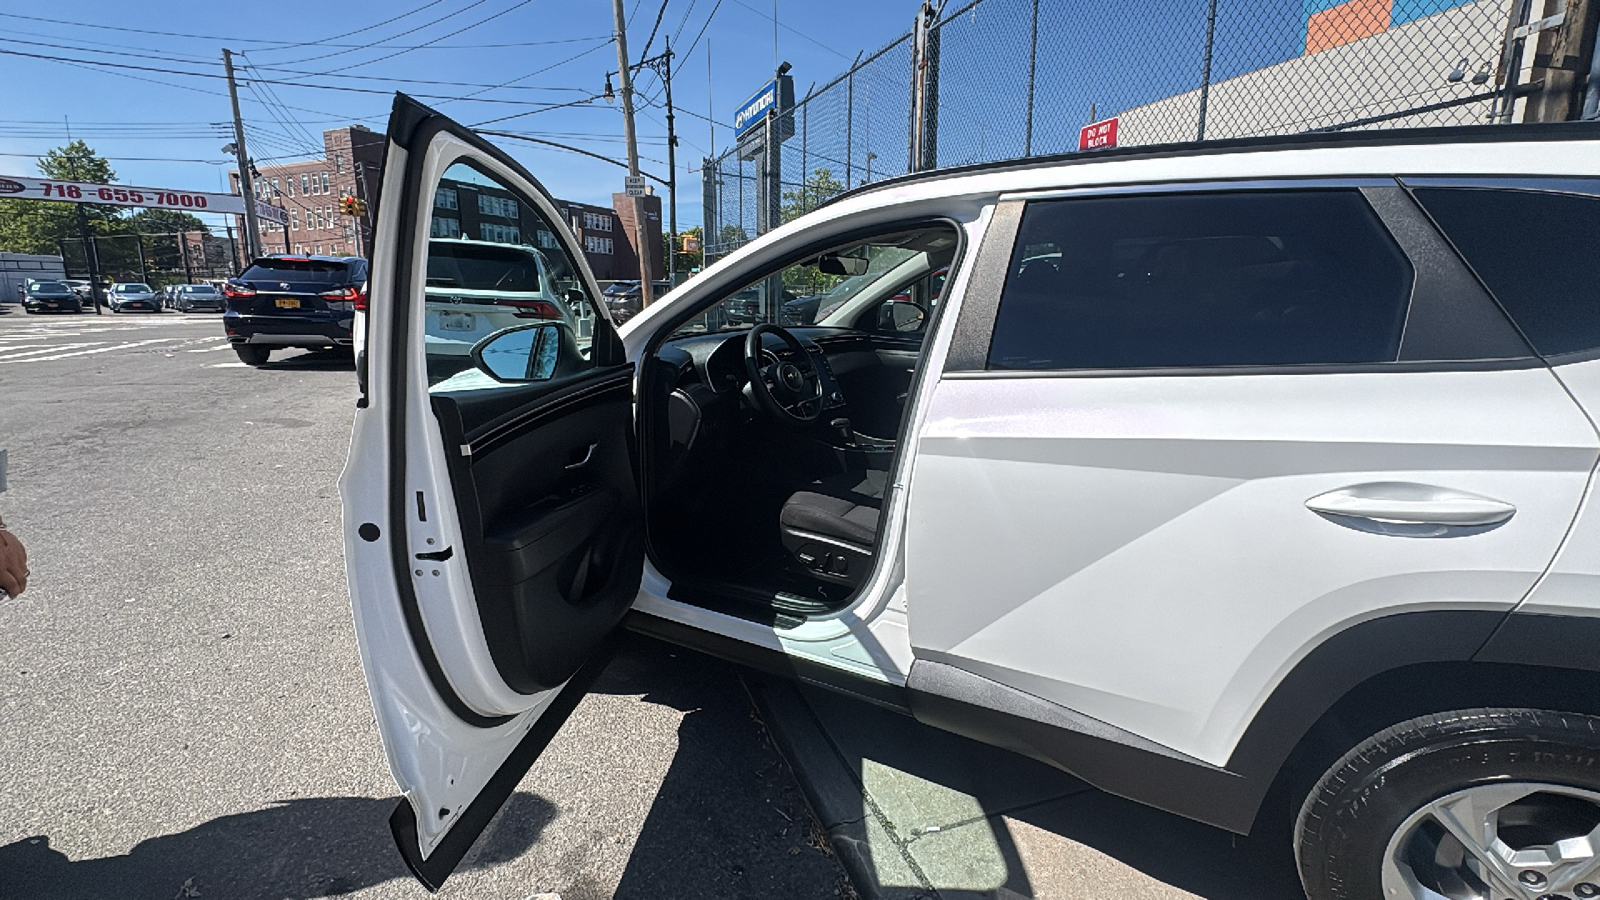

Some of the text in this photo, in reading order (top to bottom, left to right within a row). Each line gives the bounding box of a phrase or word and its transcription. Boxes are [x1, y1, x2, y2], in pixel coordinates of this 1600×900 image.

[744, 89, 774, 122] HYUNDAI
[1087, 123, 1111, 139] DO NOT
[1087, 135, 1108, 149] BLOCK
